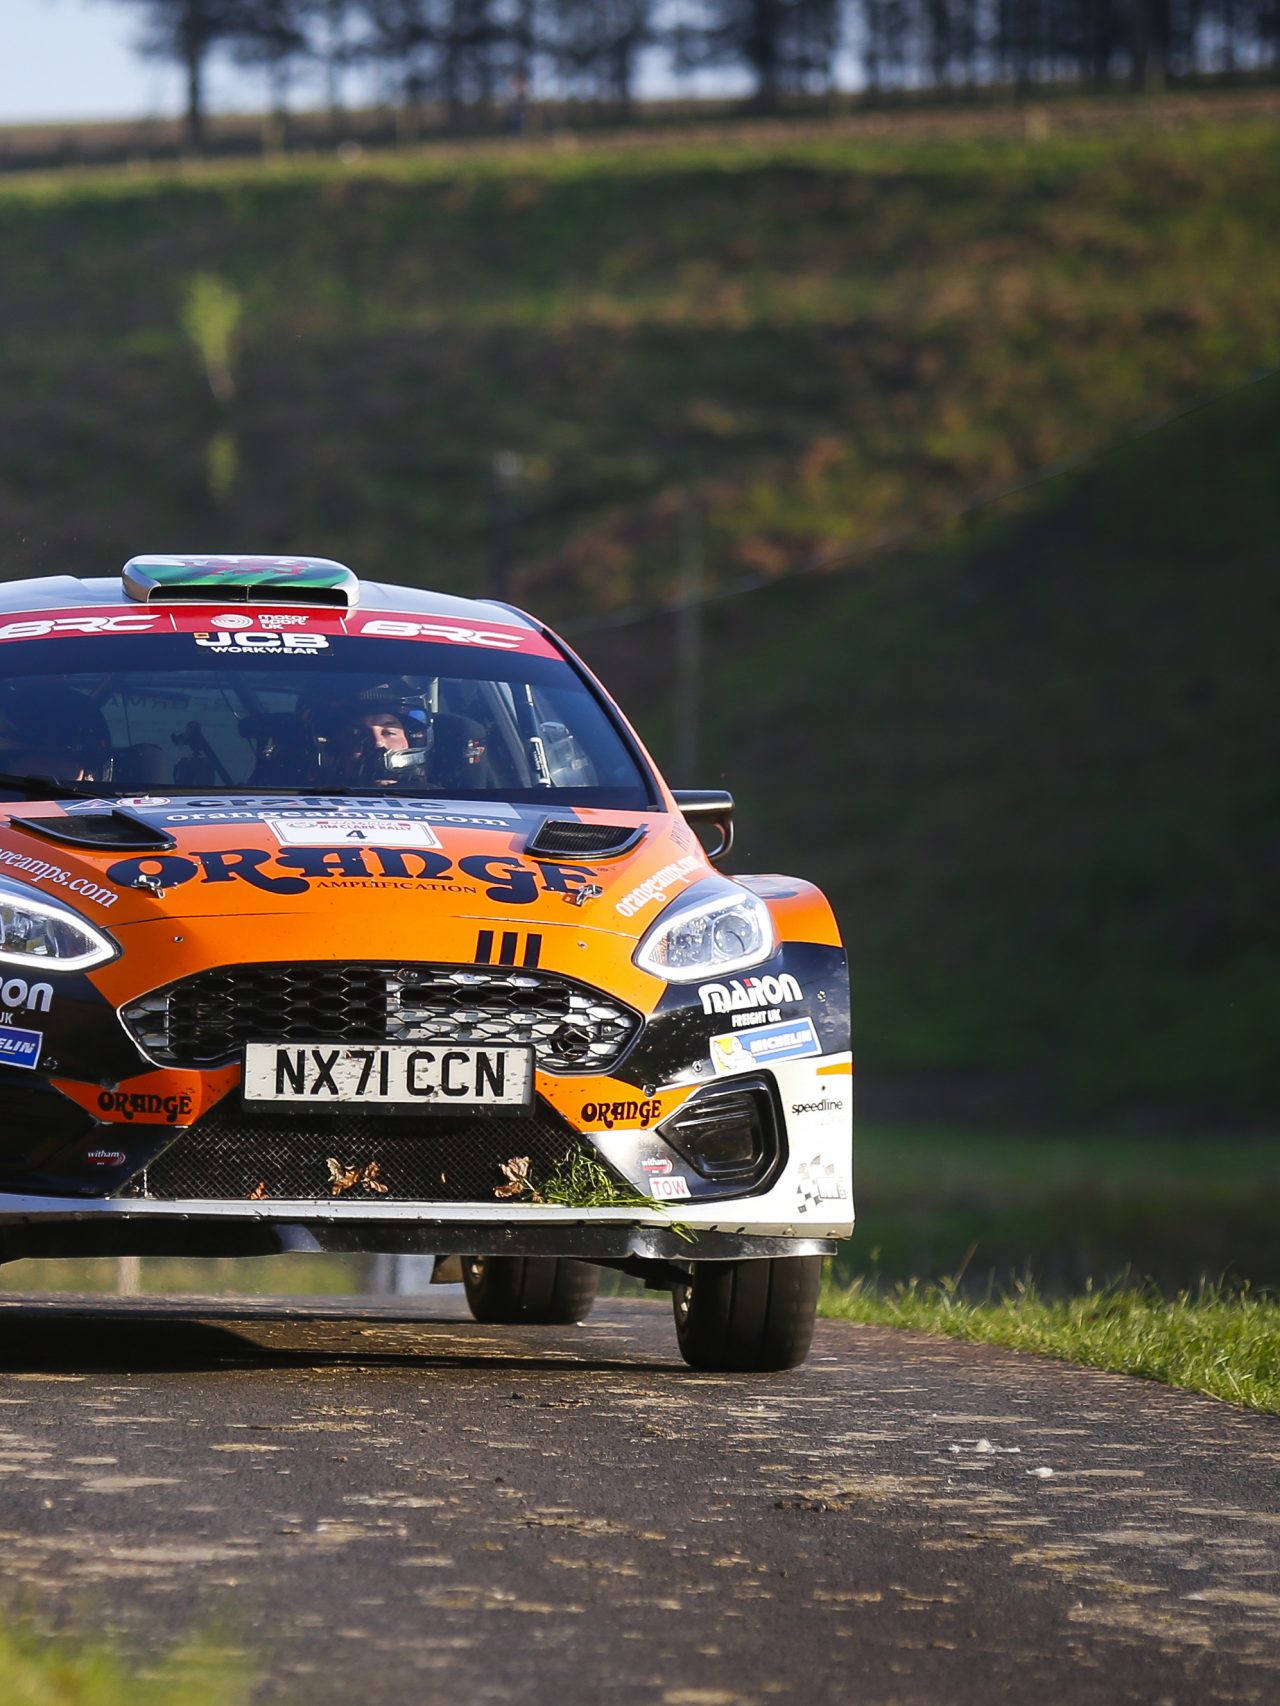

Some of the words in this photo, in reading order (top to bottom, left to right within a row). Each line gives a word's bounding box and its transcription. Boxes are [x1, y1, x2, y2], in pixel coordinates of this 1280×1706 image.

[195, 631, 330, 649] JCB
[360, 620, 526, 649] BRC
[210, 646, 319, 655] WORKWEAR
[166, 811, 510, 827] orangeamps.com
[345, 829, 368, 840] 4
[106, 847, 598, 906] ORANGE
[317, 881, 477, 894] AMPLIFICATION
[731, 1010, 767, 1028] FREIGHT
[769, 1007, 782, 1023] UK
[750, 1029, 813, 1051] MICHELIN
[275, 1049, 388, 1096] NX71
[406, 1051, 505, 1097] CCN
[97, 1091, 192, 1123] ORANGE
[581, 1100, 662, 1129] ORANGE
[791, 1099, 843, 1116] speedline
[87, 1150, 120, 1158] witham
[652, 1180, 687, 1197] TOW
